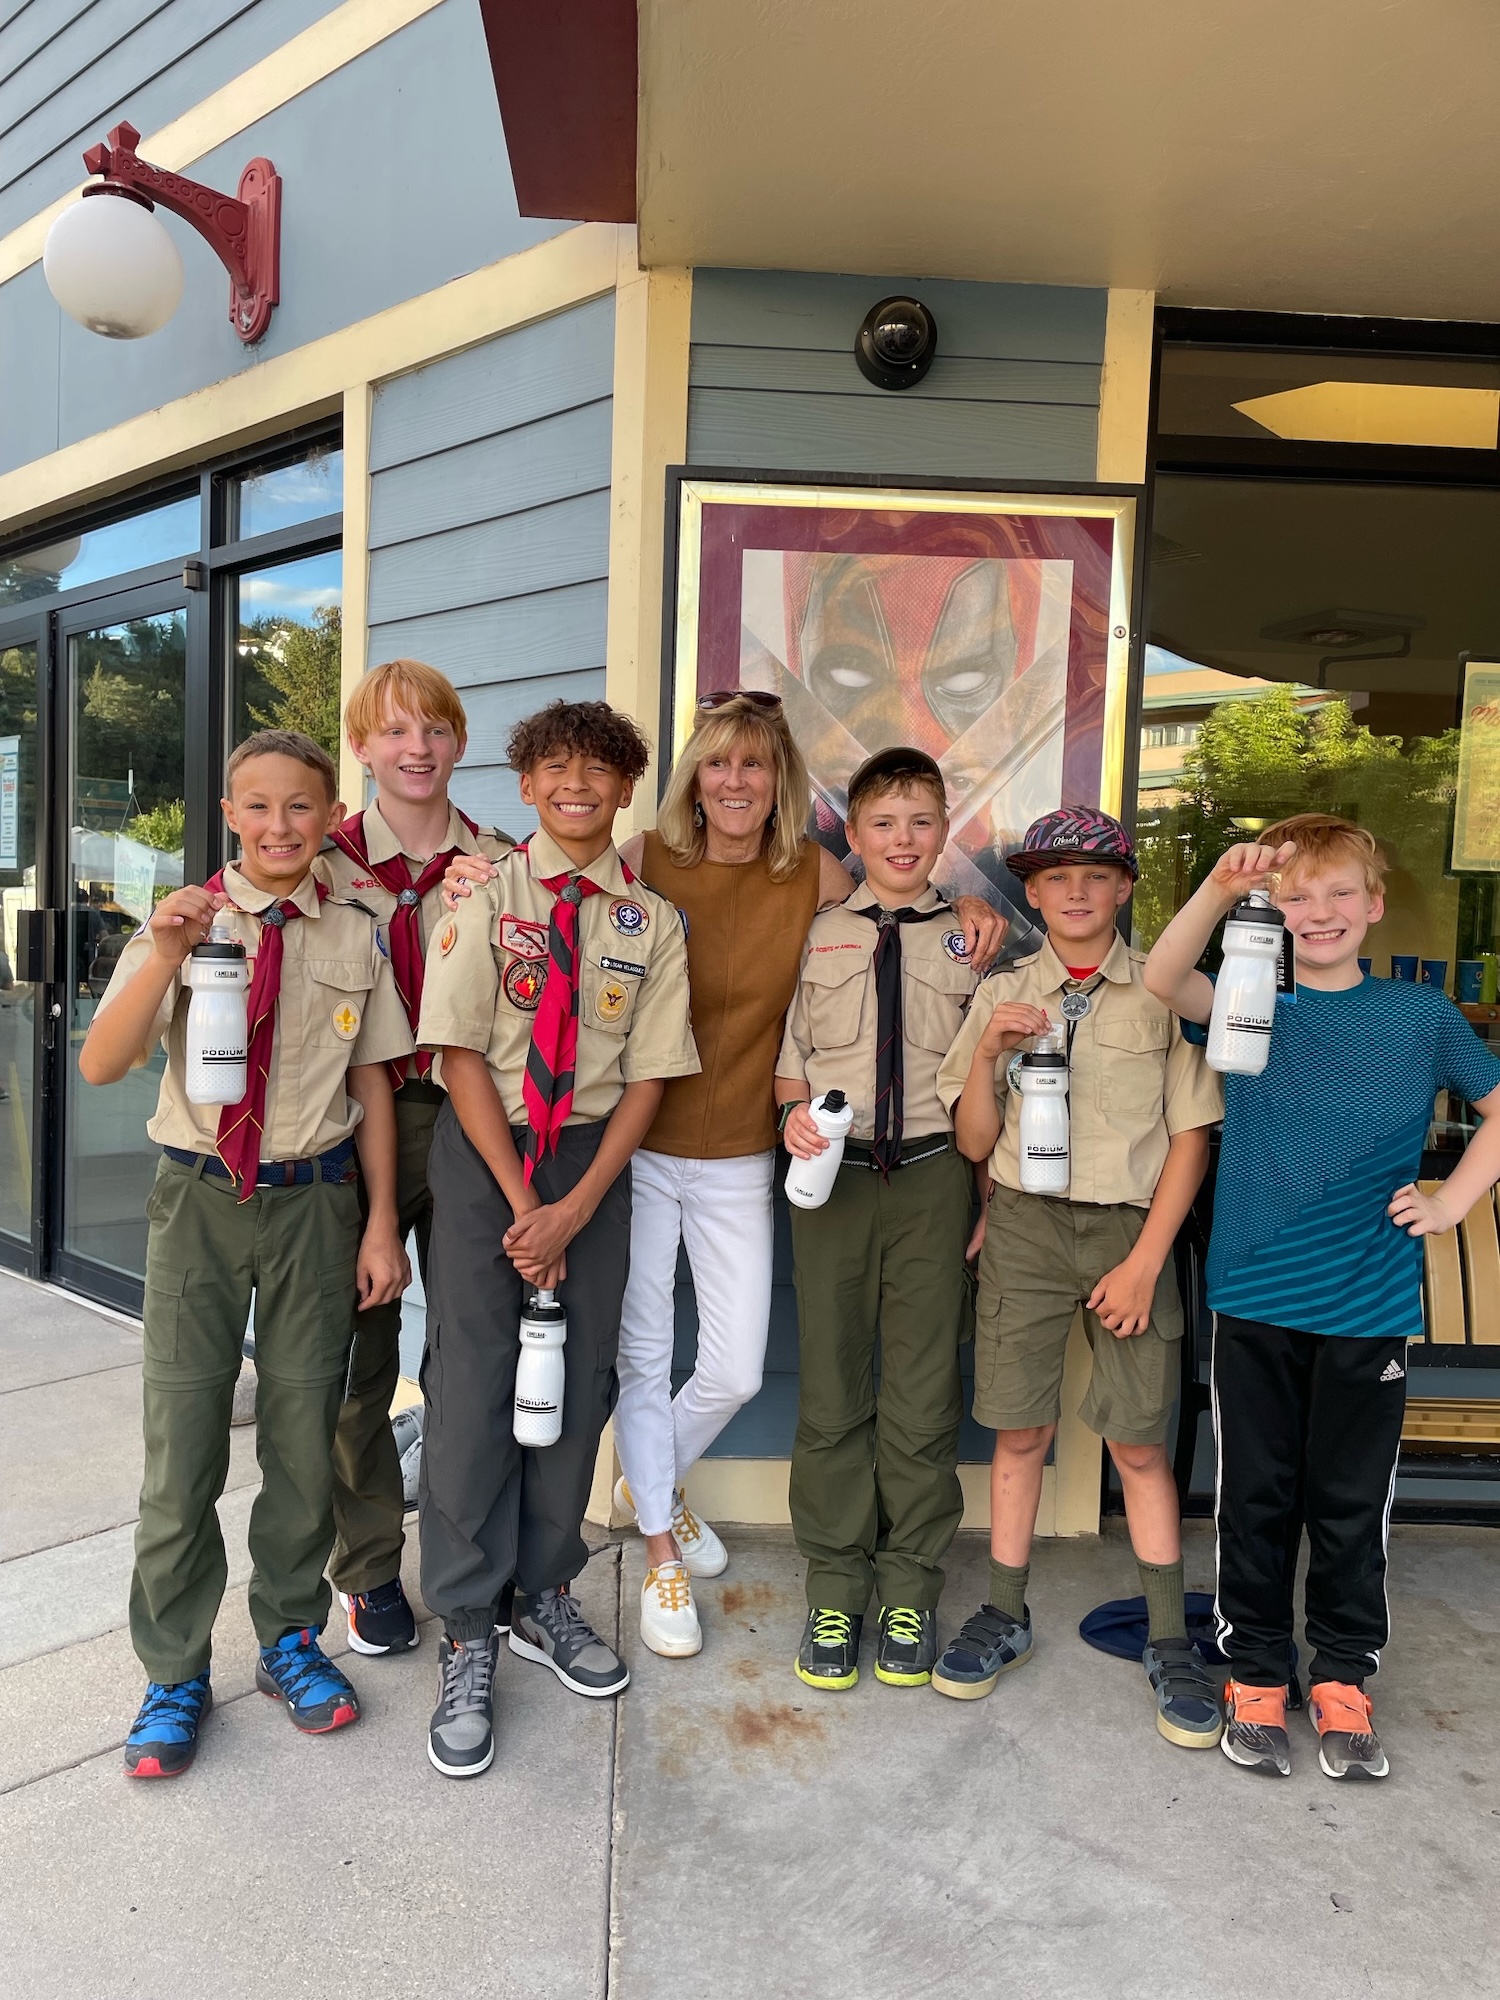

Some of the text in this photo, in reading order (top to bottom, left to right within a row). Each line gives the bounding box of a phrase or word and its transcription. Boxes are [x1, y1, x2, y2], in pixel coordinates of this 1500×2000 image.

[1249, 935, 1275, 945] CAMELBAK
[214, 970, 239, 979] CAMELBAK
[1227, 1015, 1270, 1025] PODIUM
[1380, 1369, 1405, 1382] adidas
[516, 1396, 550, 1407] PODIUM
